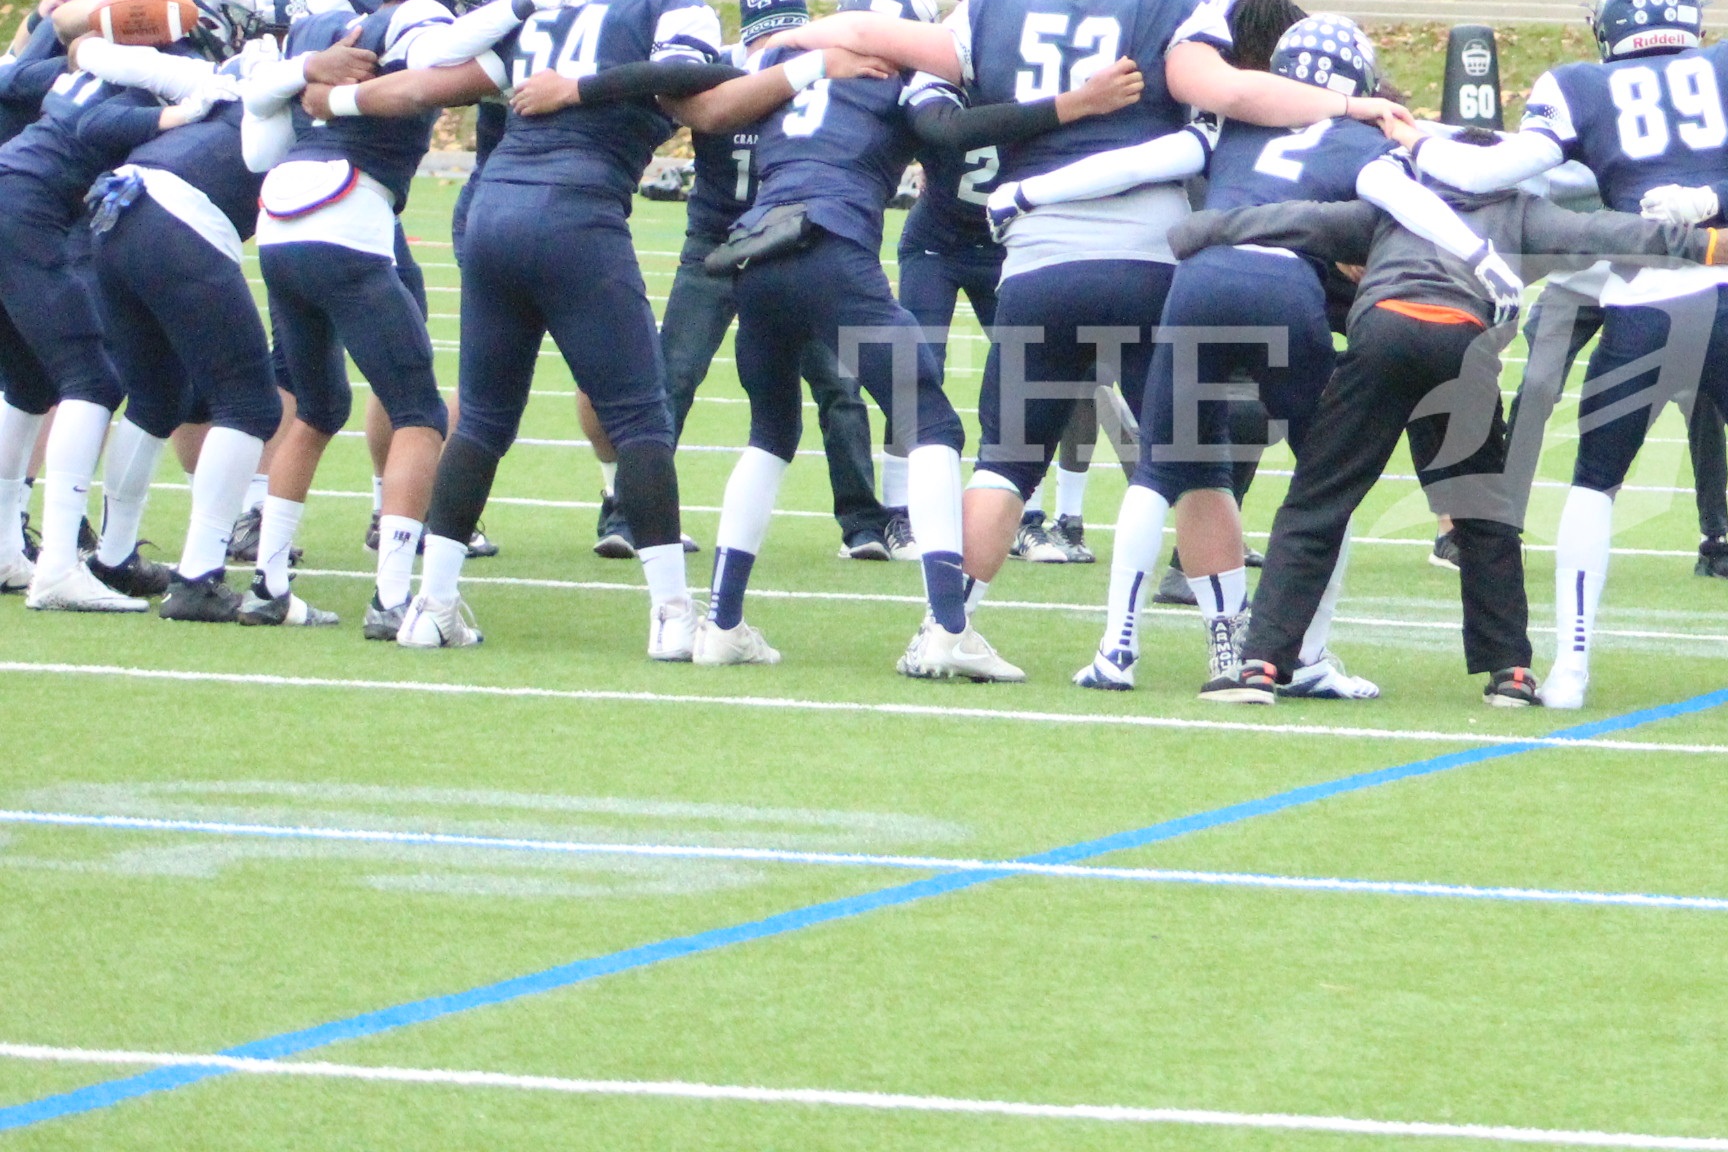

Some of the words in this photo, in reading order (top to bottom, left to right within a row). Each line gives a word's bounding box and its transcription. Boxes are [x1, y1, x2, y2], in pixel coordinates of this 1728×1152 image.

[513, 2, 610, 89] 54
[1014, 11, 1121, 104] 52
[1632, 34, 1686, 50] Riddell
[1458, 83, 1496, 119] 60
[1609, 56, 1728, 161] 89
[957, 145, 1000, 207] 2
